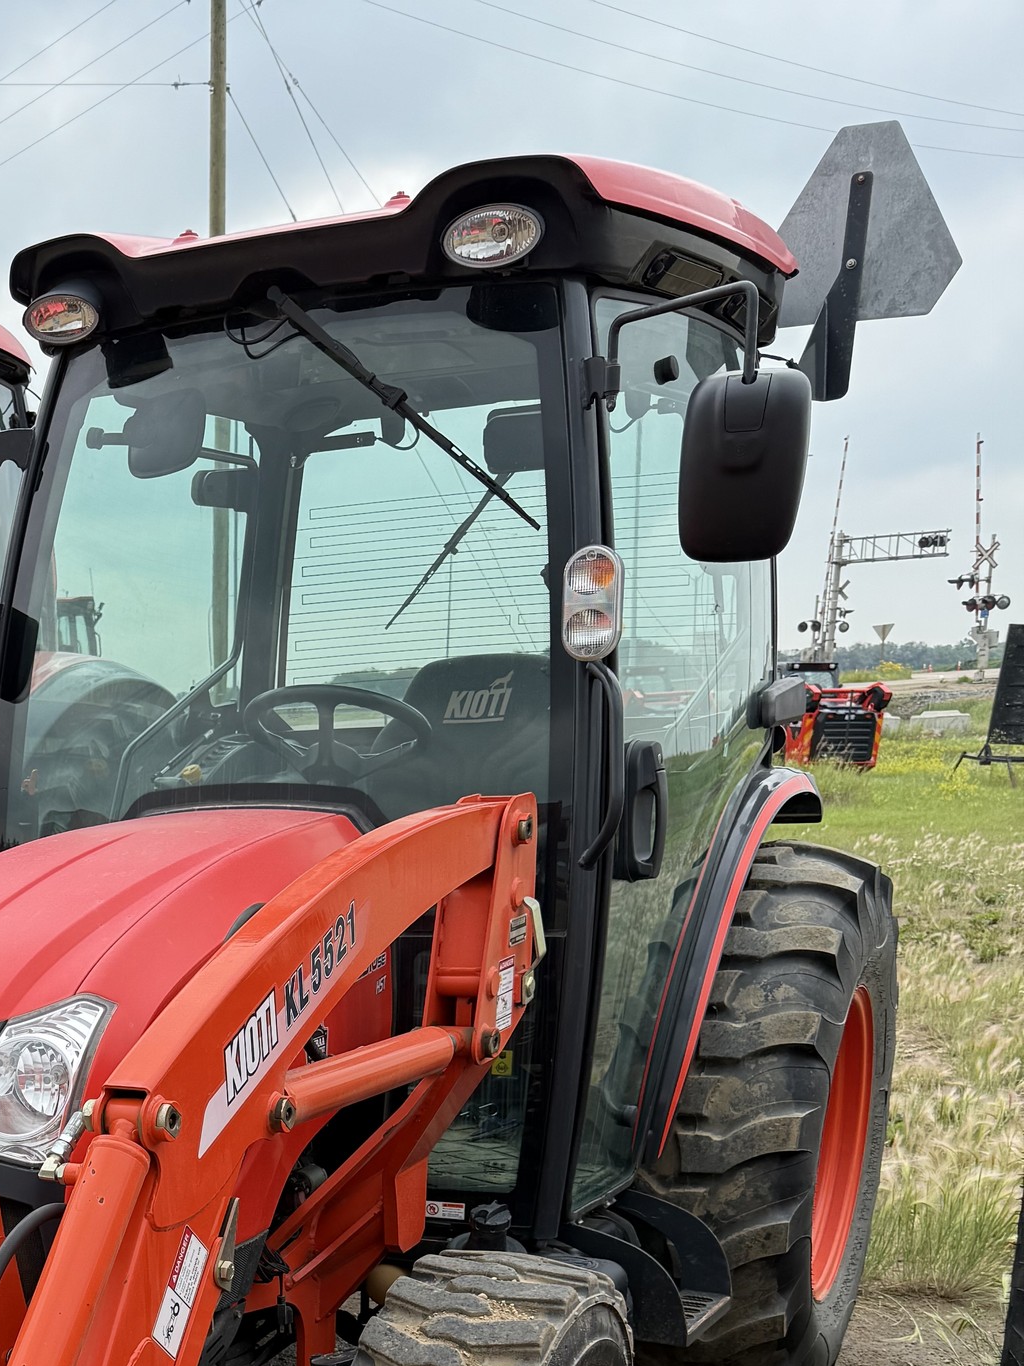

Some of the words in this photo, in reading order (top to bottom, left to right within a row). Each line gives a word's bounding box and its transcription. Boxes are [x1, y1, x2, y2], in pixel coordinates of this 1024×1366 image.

[443, 687, 513, 719] KIOTI
[223, 987, 279, 1106] KIOTI
[174, 1232, 191, 1274] DANGER
